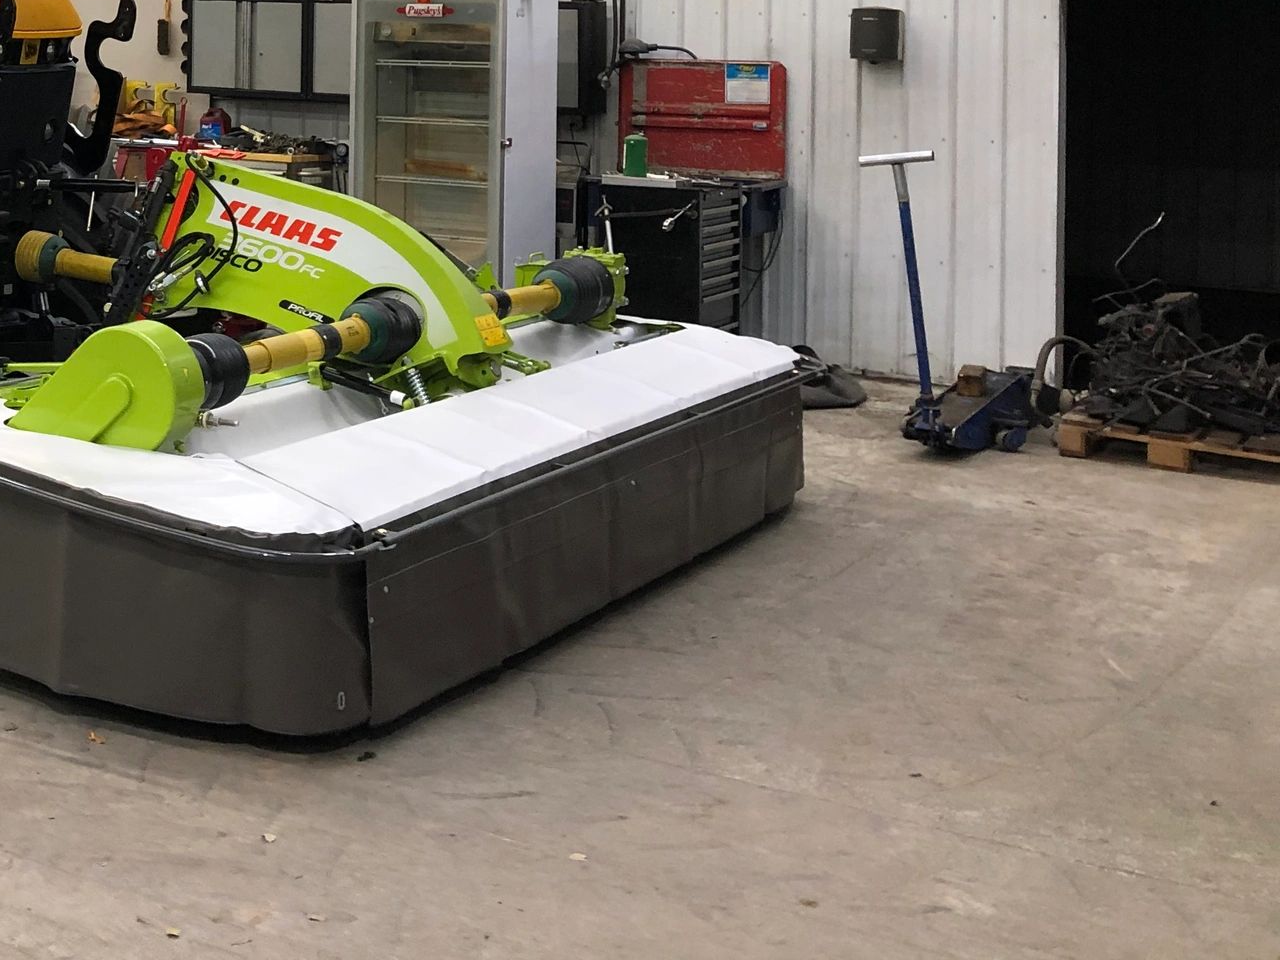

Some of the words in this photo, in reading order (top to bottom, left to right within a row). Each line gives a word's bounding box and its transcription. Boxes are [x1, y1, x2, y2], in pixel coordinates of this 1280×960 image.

[219, 200, 344, 253] CLAAS
[208, 247, 263, 273] ISCO
[287, 303, 325, 323] PROFIL
